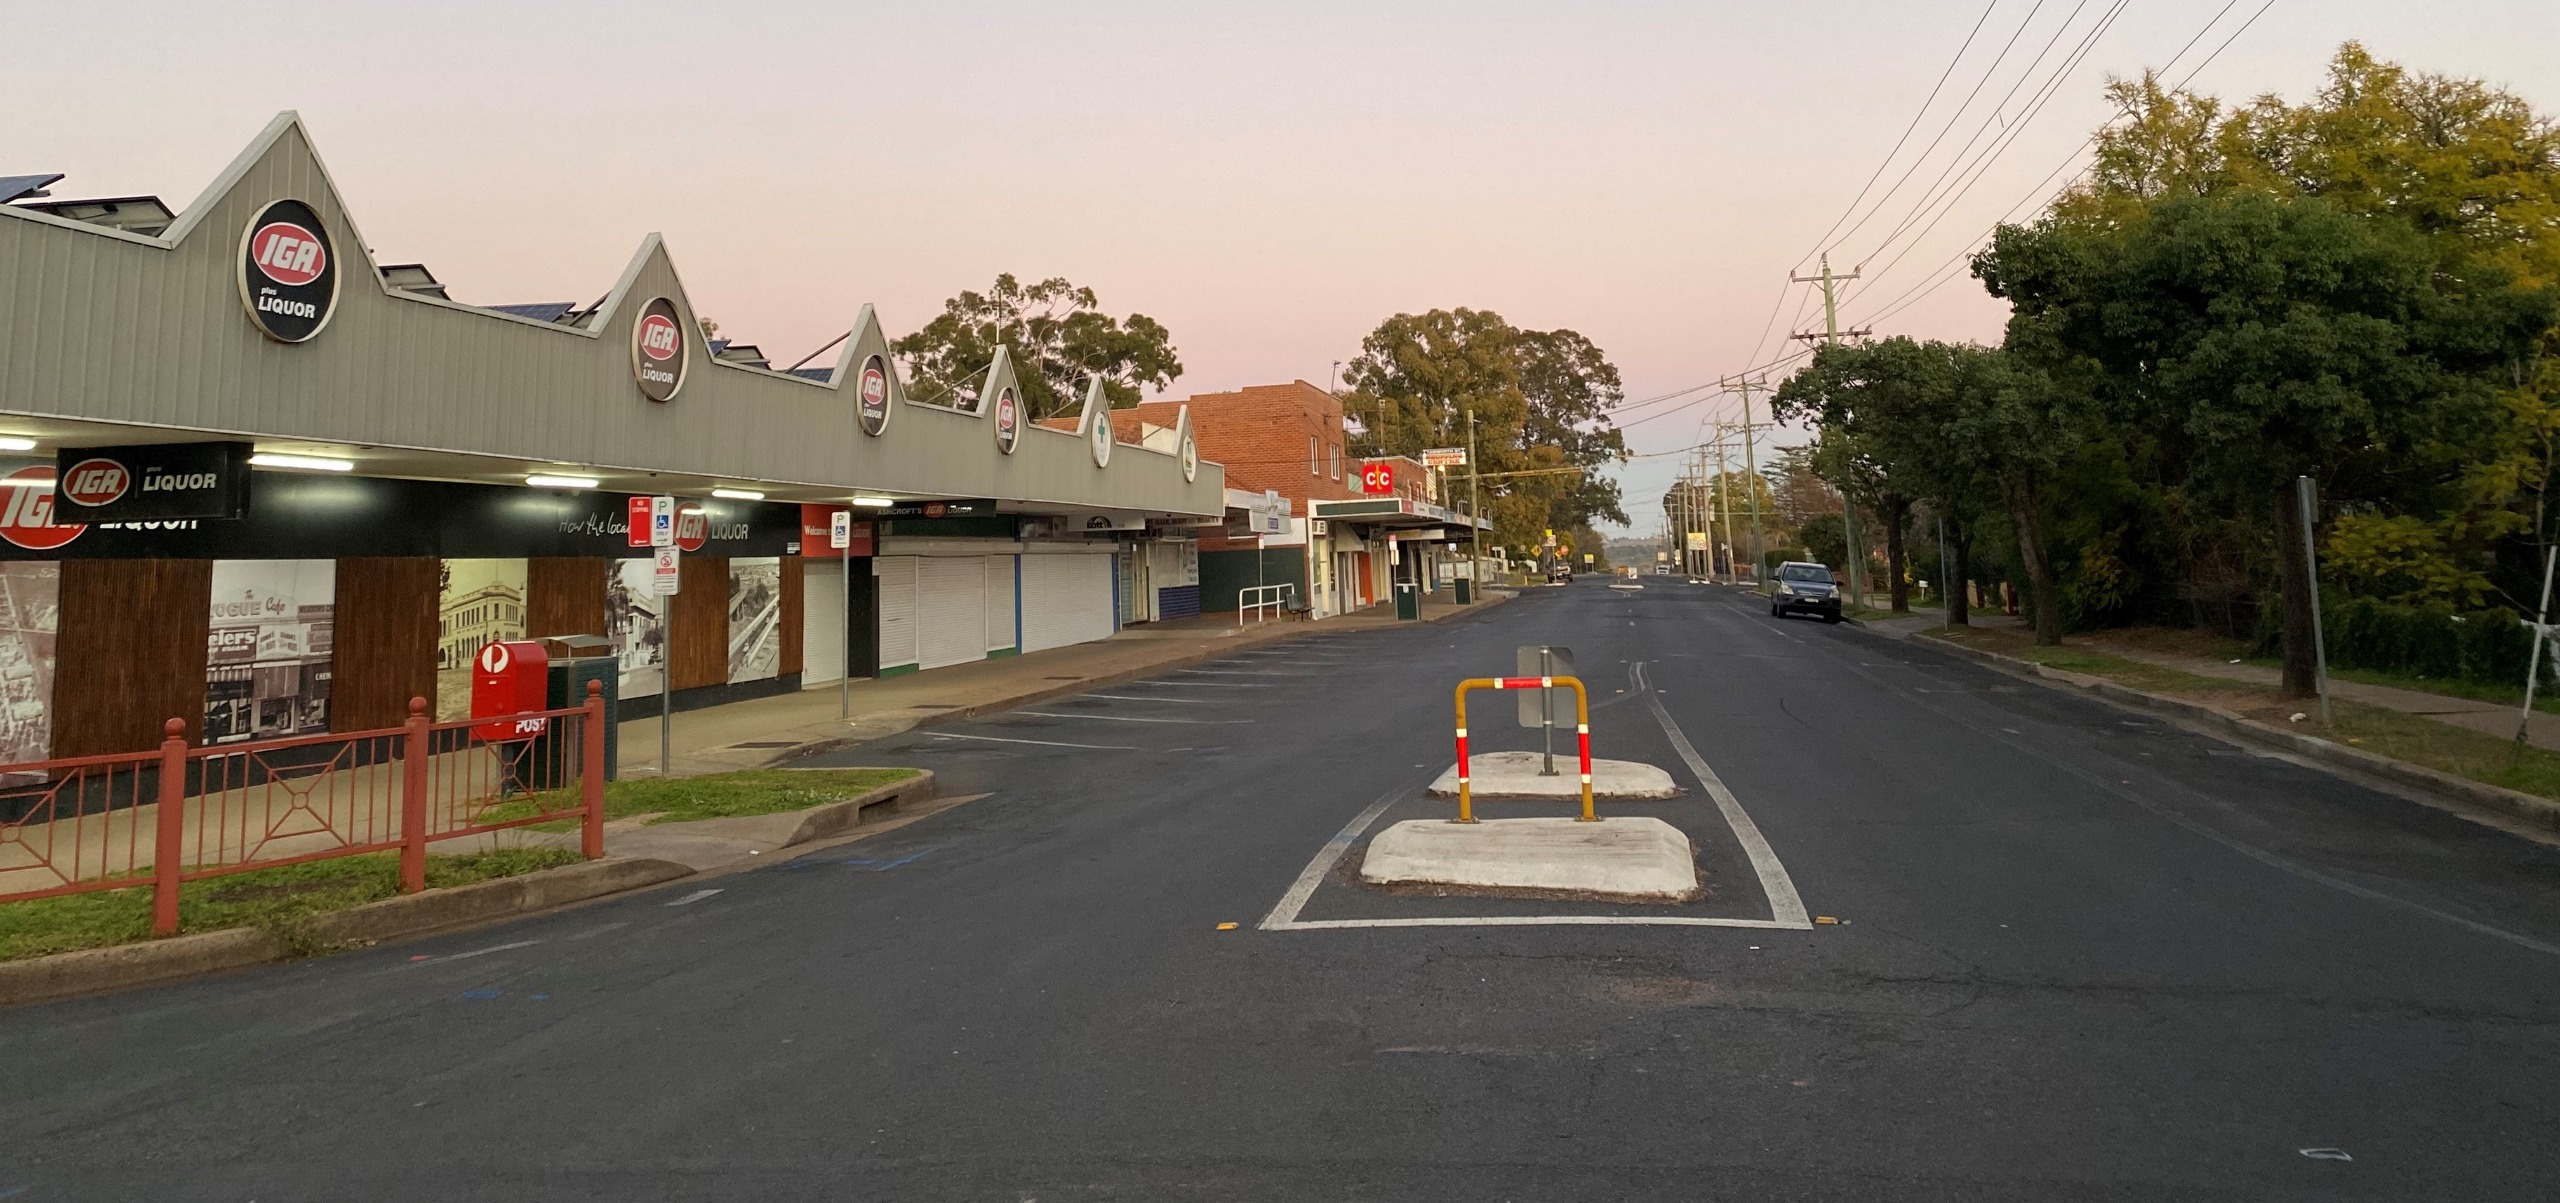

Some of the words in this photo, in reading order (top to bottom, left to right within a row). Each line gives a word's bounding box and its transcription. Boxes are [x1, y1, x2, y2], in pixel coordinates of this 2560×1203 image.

[260, 233, 319, 274] IGA
[261, 287, 277, 296] plus
[258, 296, 316, 319] LIQUOR
[643, 322, 675, 352] IGA
[642, 368, 674, 384] LIQUOR
[864, 375, 883, 397] IGA
[863, 407, 882, 420] LIQUOR
[72, 469, 122, 495] IGA
[143, 473, 217, 491] LIQUOR
[659, 501, 667, 512] P
[877, 508, 922, 516] ASHCROFT'S
[927, 505, 943, 514] IGA
[586, 512, 605, 537] the
[675, 513, 704, 539] IGA
[711, 523, 749, 540] LIQUOR
[804, 525, 827, 535] Welcome
[266, 597, 285, 615] Cafe
